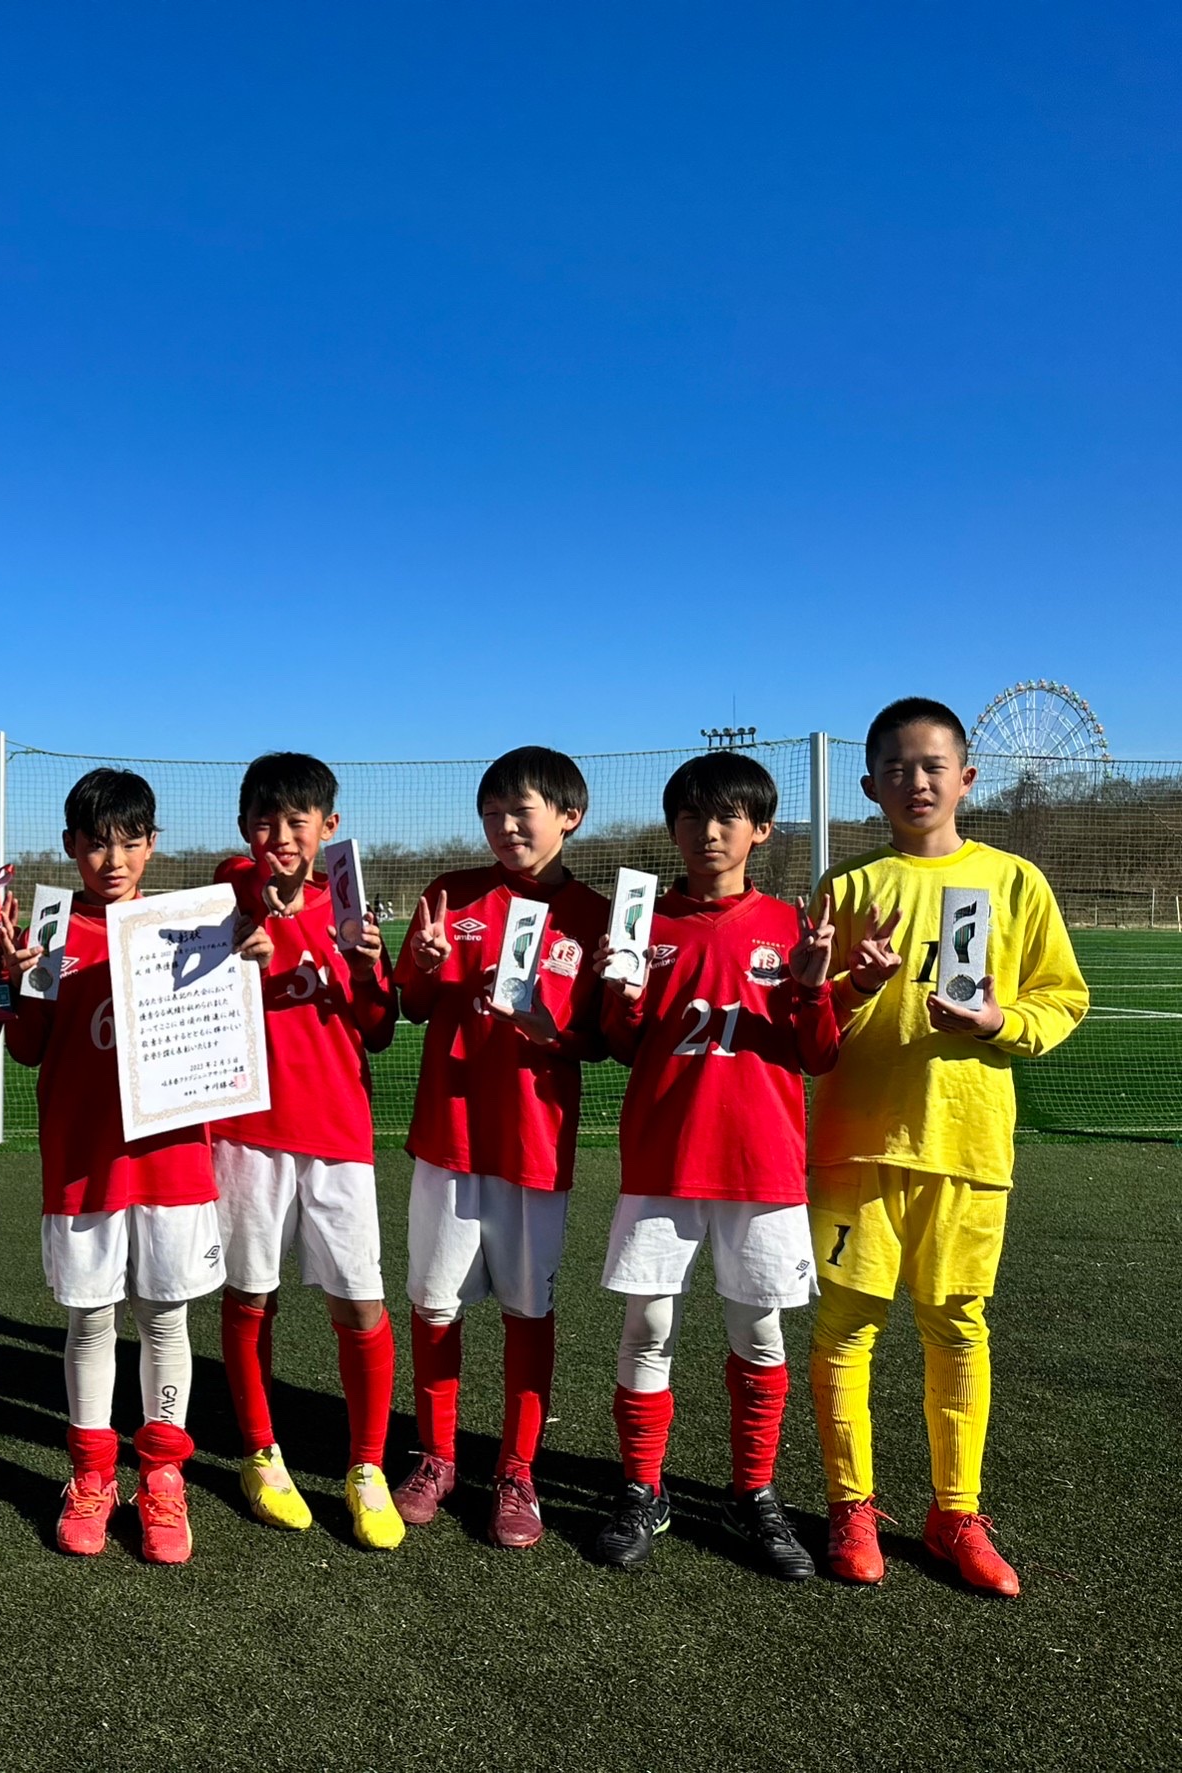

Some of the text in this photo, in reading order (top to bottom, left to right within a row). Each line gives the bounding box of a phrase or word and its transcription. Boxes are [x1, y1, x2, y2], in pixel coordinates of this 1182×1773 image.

[165, 928, 202, 946] 表彰状
[454, 933, 482, 942] umbro
[672, 998, 739, 1056] 21
[825, 1223, 852, 1267] 1
